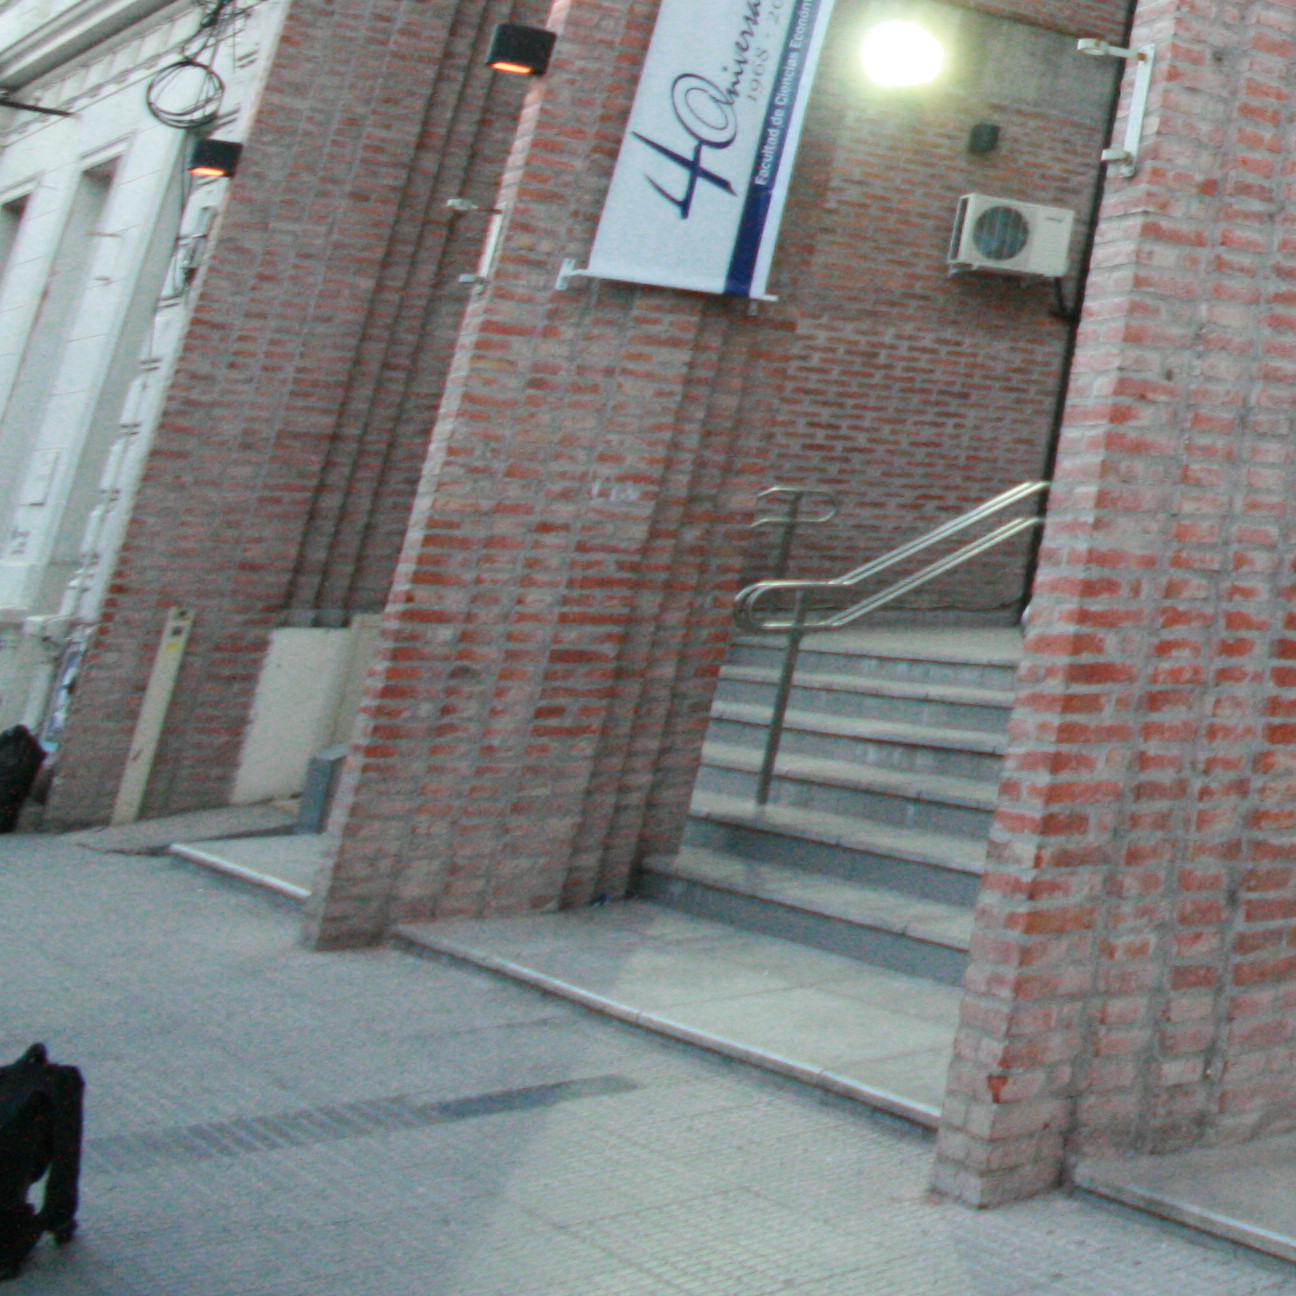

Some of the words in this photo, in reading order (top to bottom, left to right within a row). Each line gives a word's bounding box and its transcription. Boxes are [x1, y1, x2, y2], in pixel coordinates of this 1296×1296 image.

[746, 47, 769, 102] 1968
[775, 50, 799, 105] Ciencias
[770, 107, 786, 125] de
[754, 127, 780, 186] Facultad
